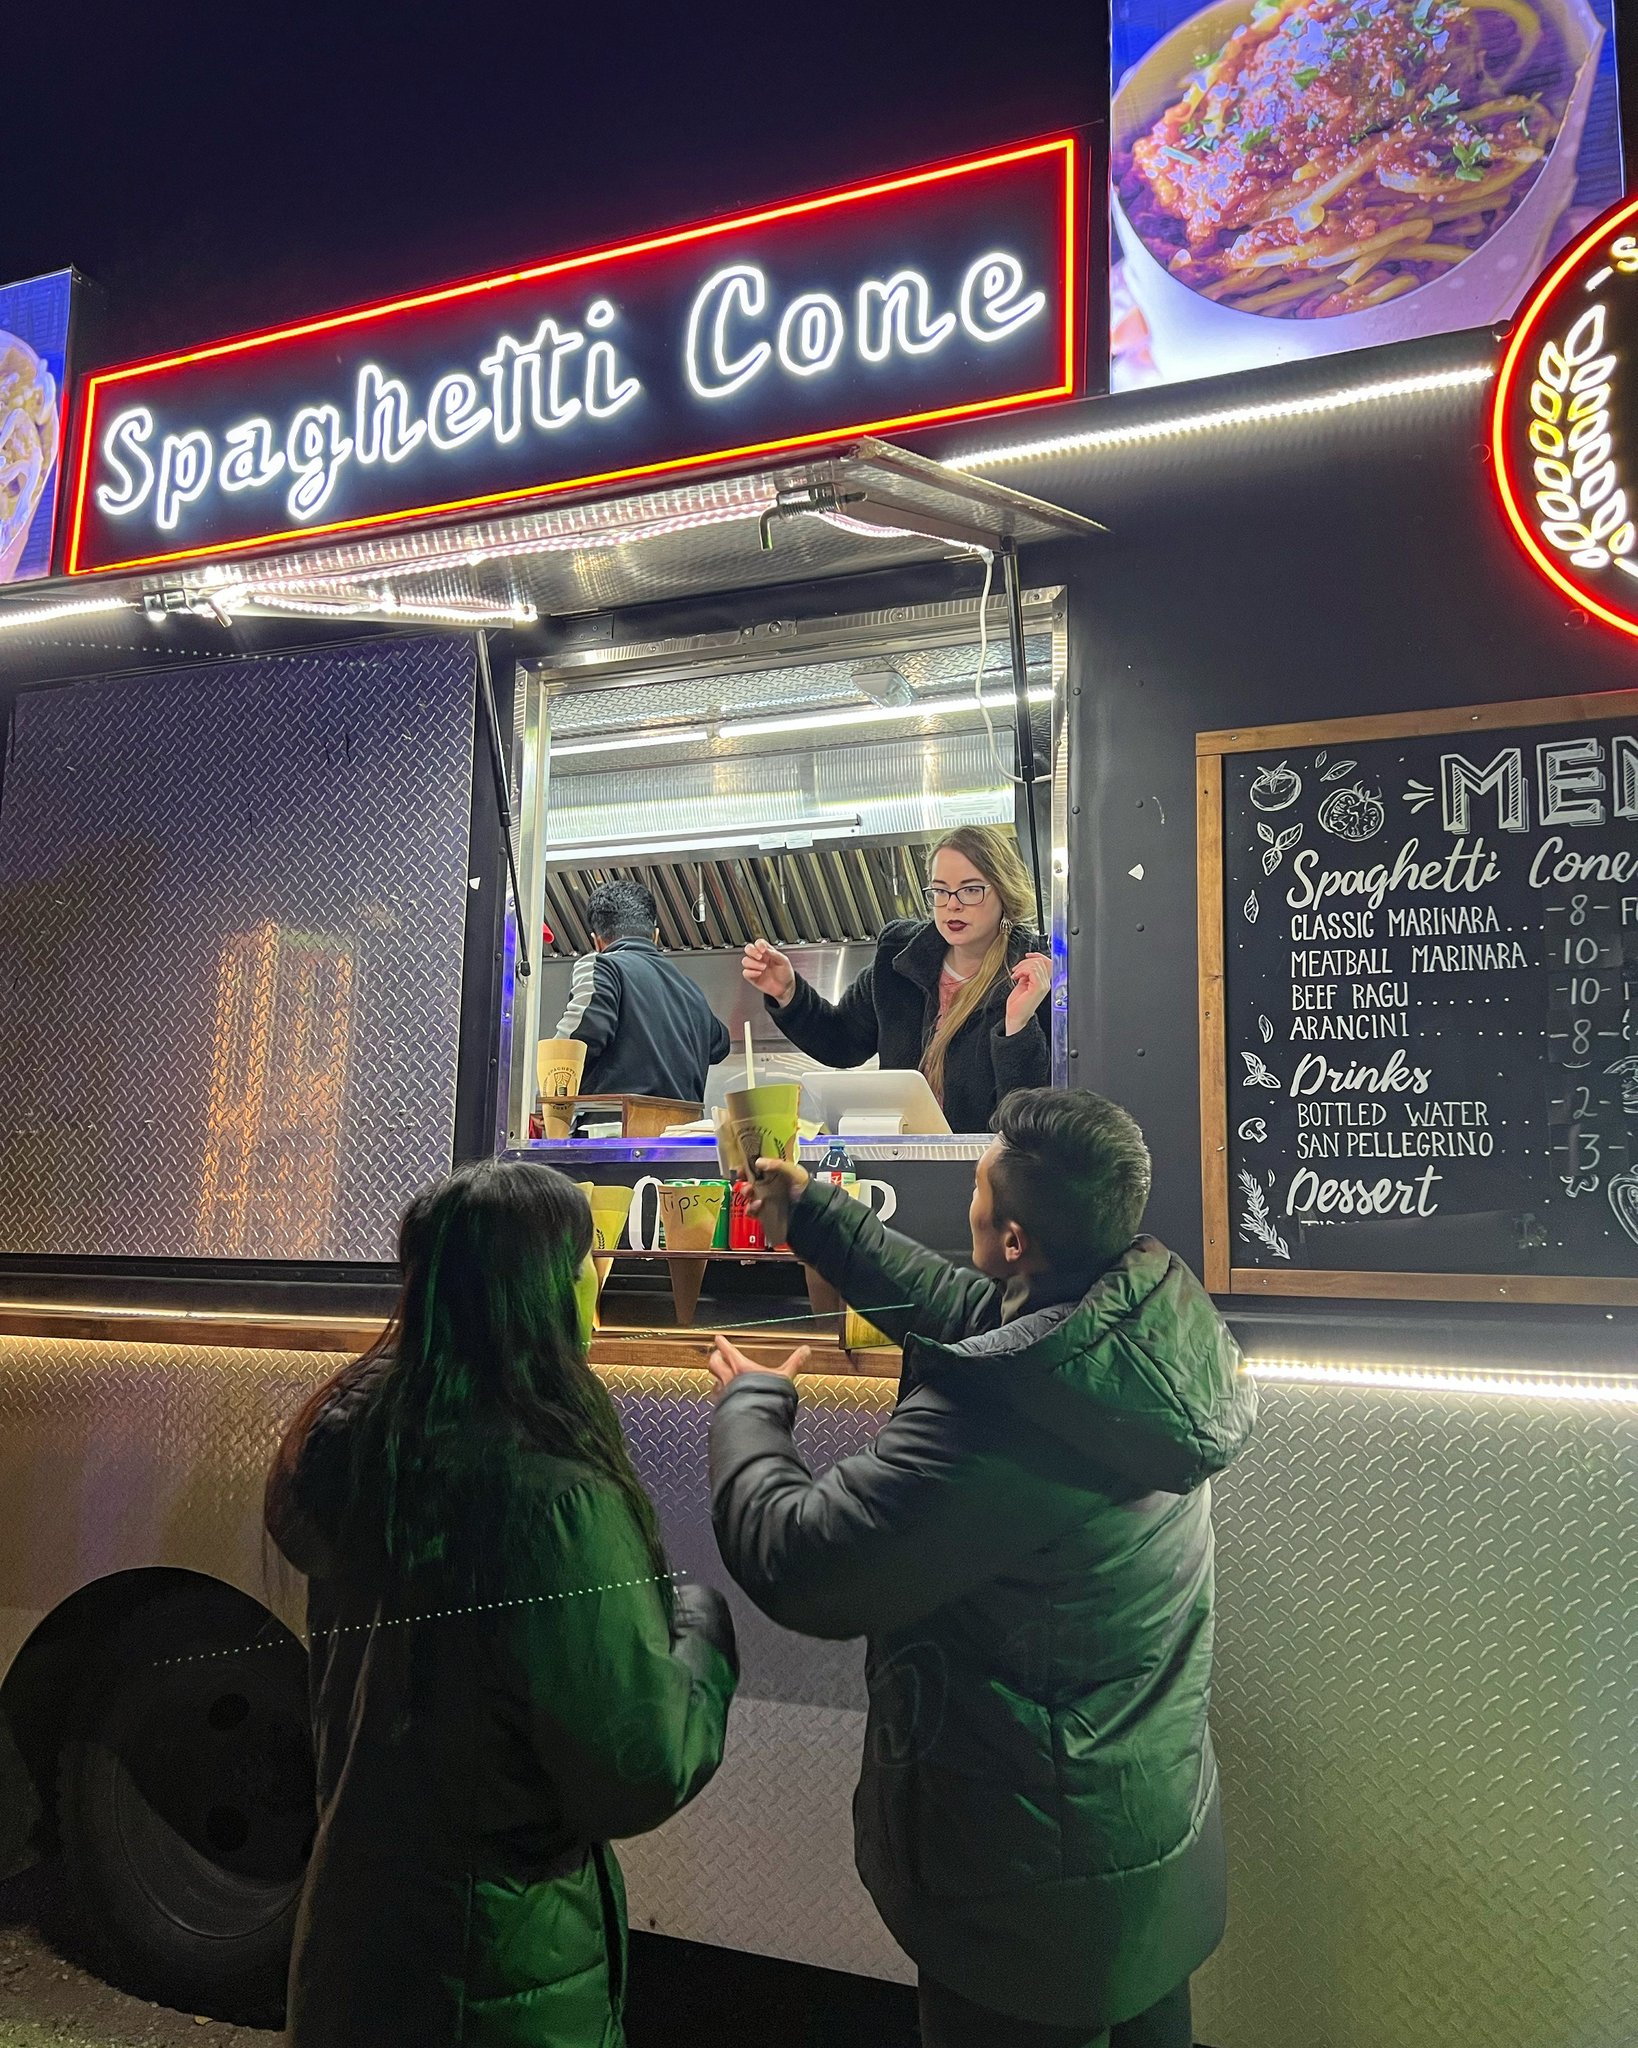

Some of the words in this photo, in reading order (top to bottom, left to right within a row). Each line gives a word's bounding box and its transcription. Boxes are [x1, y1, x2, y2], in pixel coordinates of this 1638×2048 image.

[97, 300, 641, 530] Spaghetti
[686, 252, 1046, 398] Cone
[1286, 838, 1501, 910] Spaghetti
[1291, 910, 1375, 941] CLASSIC
[1387, 906, 1500, 937] MARINARA
[1290, 948, 1393, 978] MEATBALL
[1411, 942, 1528, 973] MARINARA
[1291, 984, 1338, 1011] BEEF
[1352, 982, 1409, 1009] RAGU
[1289, 1012, 1410, 1041] ARANCINI
[1289, 1049, 1432, 1098] Drinks
[1297, 1102, 1387, 1128] BOTTLED
[1404, 1101, 1489, 1127] WATER
[1296, 1132, 1340, 1159] SAN
[1347, 1131, 1494, 1159] PELLEGRINO
[1286, 1164, 1443, 1217] Dessert
